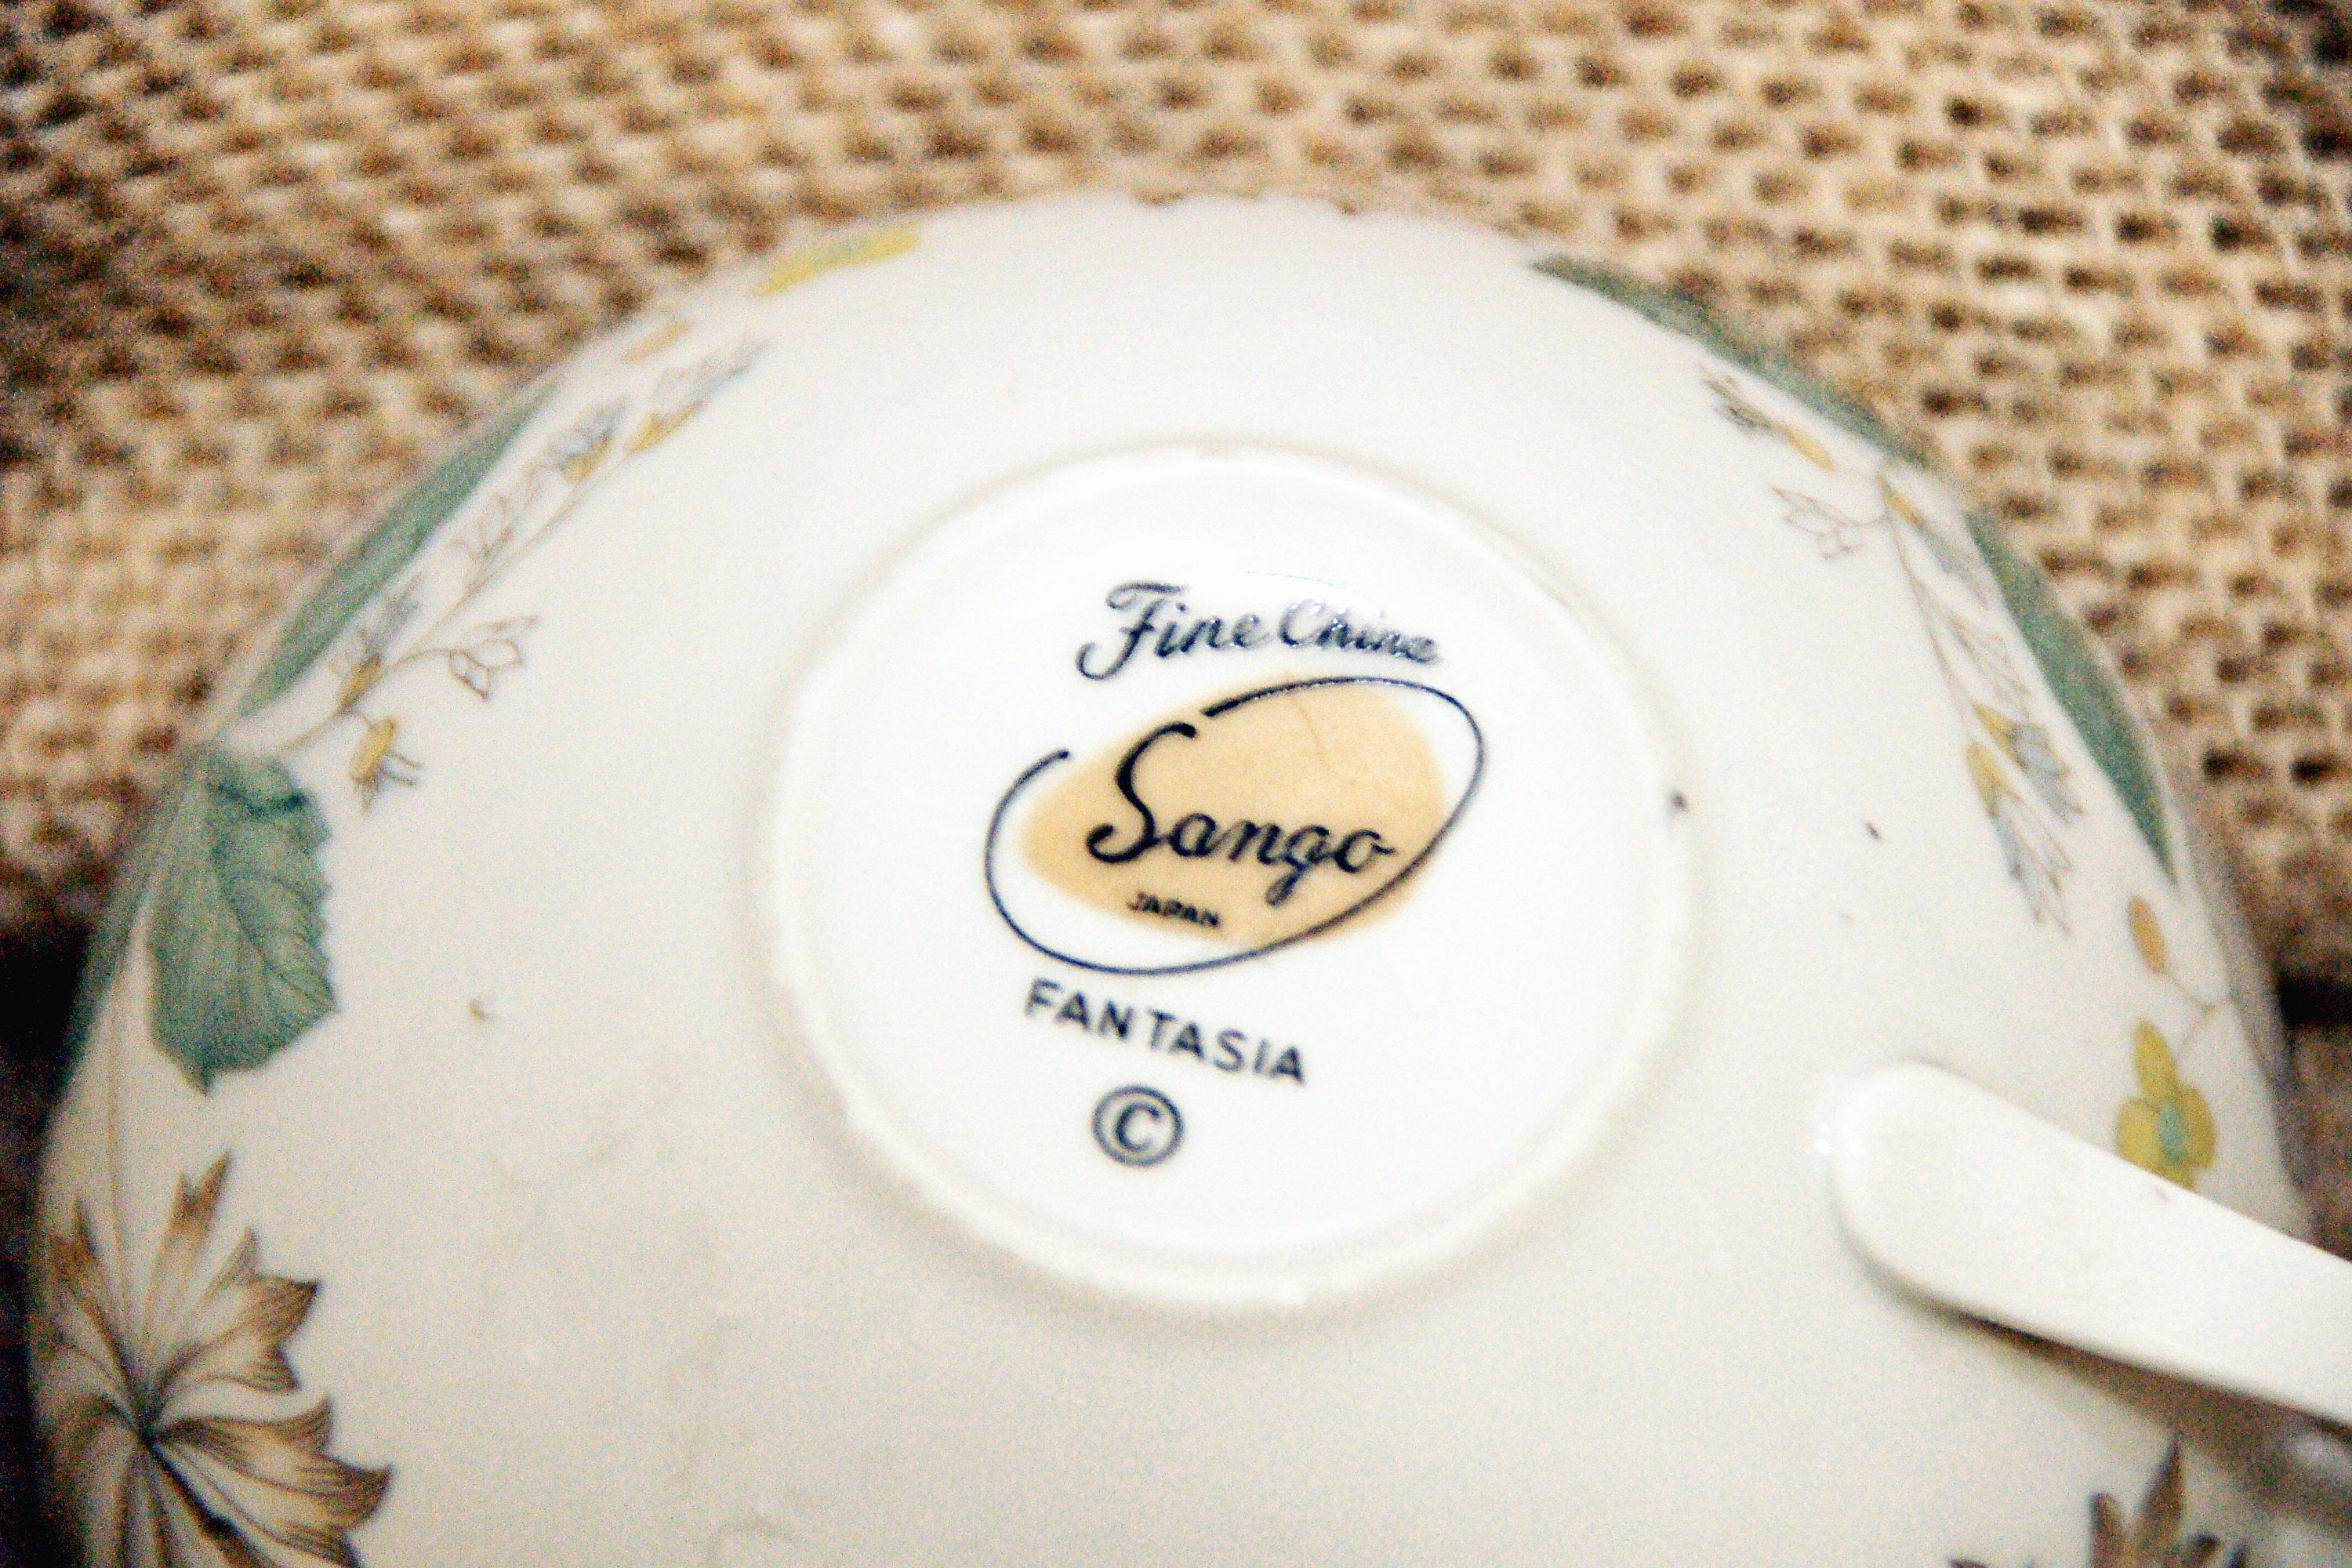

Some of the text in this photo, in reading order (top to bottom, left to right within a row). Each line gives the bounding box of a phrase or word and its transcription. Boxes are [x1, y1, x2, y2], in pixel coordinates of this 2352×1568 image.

[1076, 580, 1273, 681] Fine
[1085, 721, 1396, 907] Sango
[1127, 891, 1221, 927] JAPAN
[1025, 978, 1308, 1086] FANTASIA
